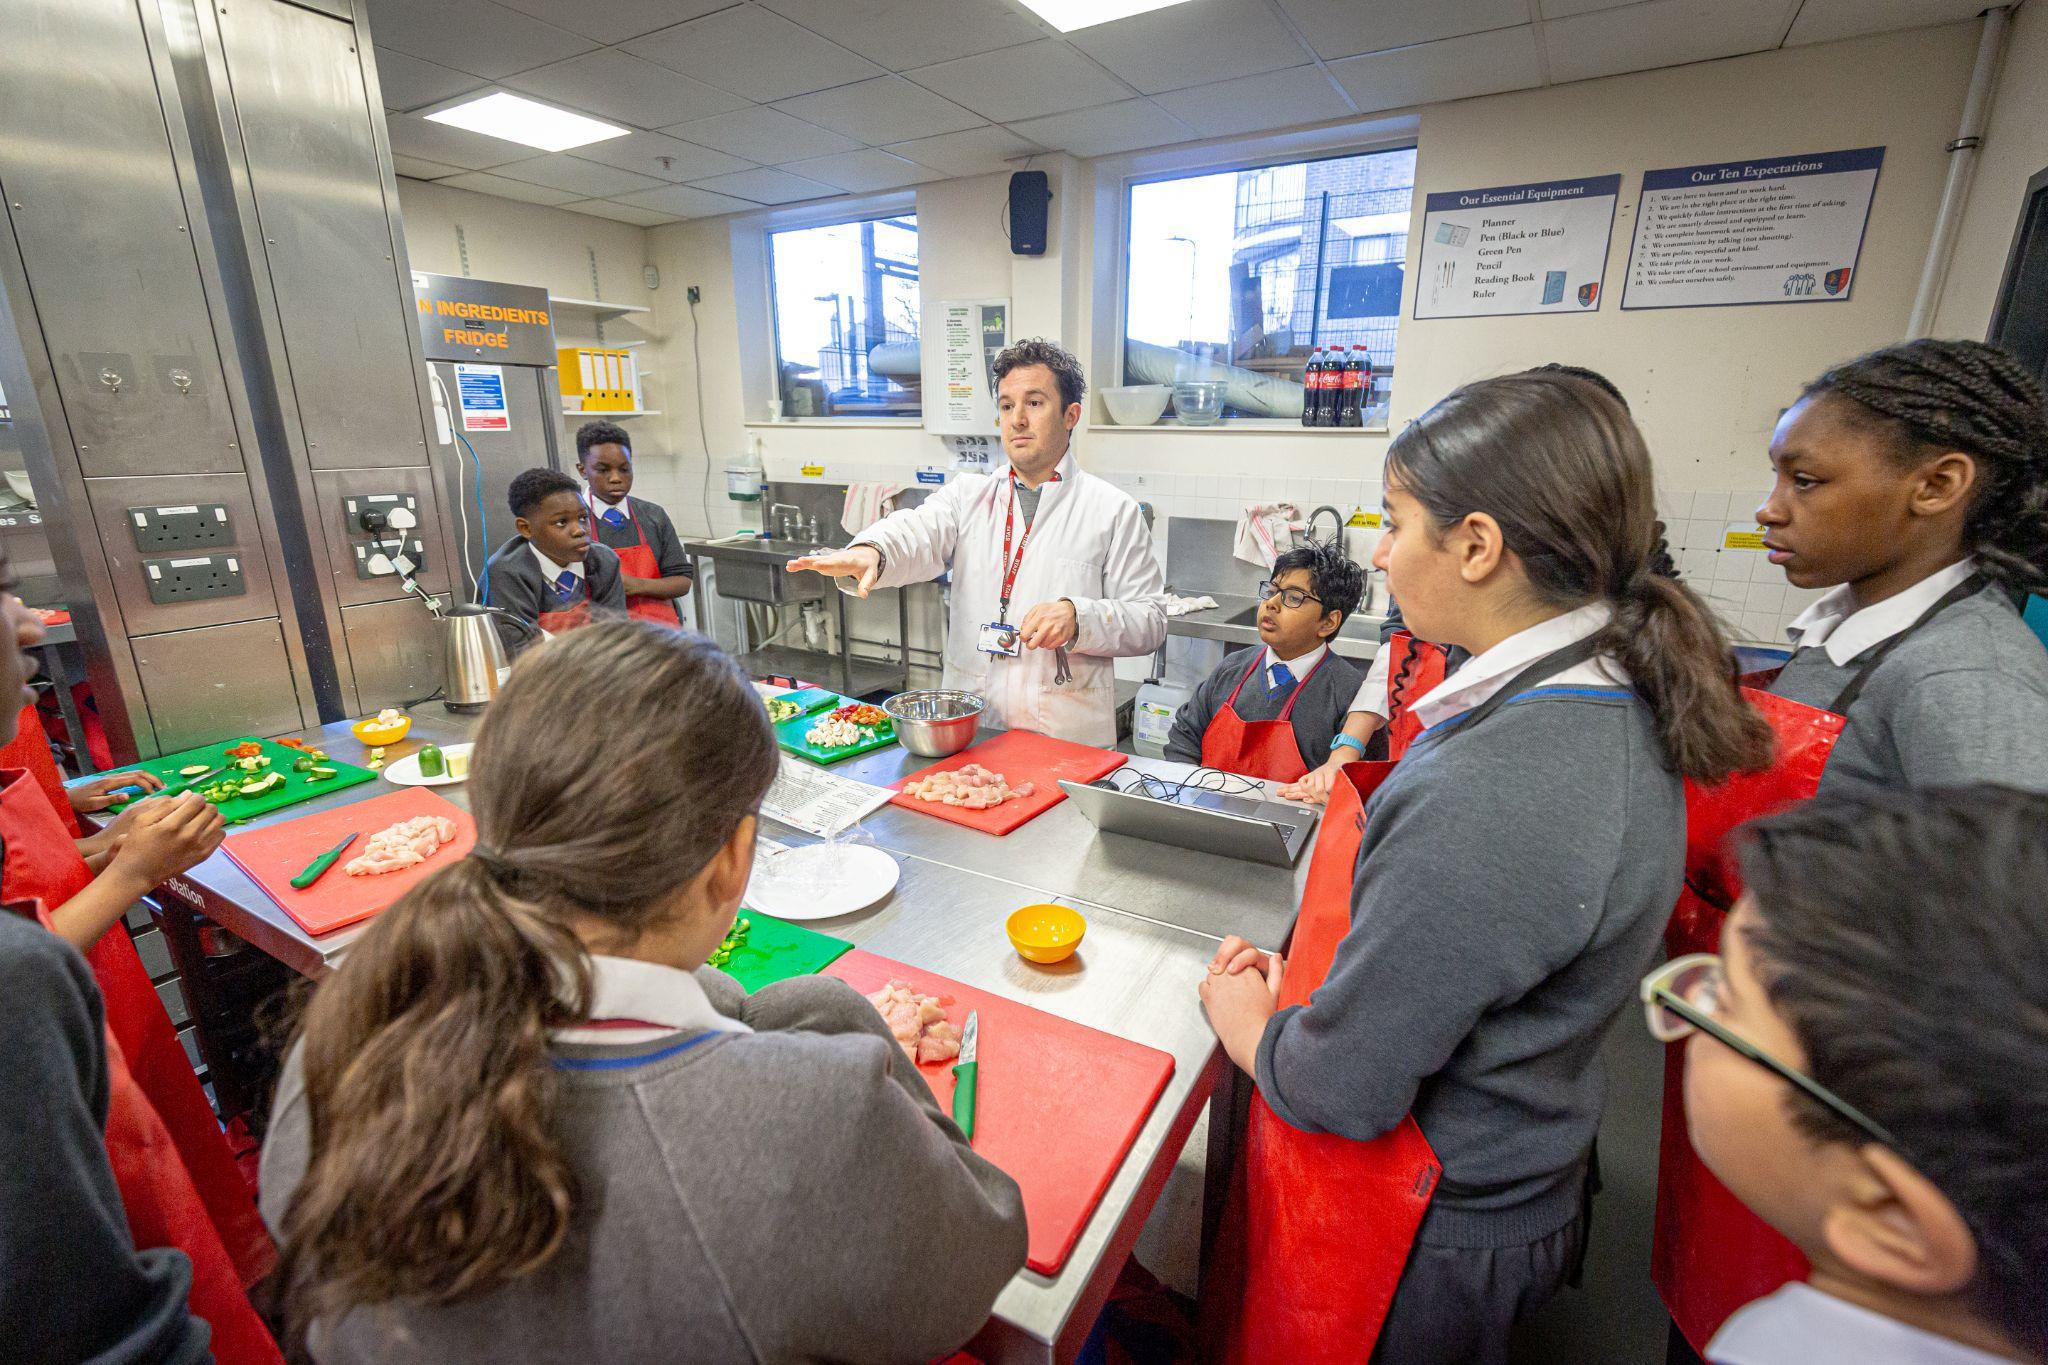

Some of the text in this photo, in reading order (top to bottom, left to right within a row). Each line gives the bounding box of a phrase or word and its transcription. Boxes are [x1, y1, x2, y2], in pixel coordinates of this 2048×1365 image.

[1691, 161, 1823, 182] Our Ten Expectations
[1460, 186, 1584, 206] Our Essential Equipment
[1703, 200, 1719, 209] right
[1720, 199, 1737, 208] place
[1760, 195, 1777, 204] right
[1669, 212, 1693, 222] quickly
[1717, 207, 1757, 215] instructions
[1822, 200, 1847, 208] asking.
[1482, 219, 1516, 228] Planner
[1679, 221, 1702, 229] smartly
[1704, 218, 1728, 226] dressed
[1744, 214, 1776, 225] equipped
[1480, 233, 1496, 242] Pen
[1498, 231, 1525, 242] (Black
[1541, 227, 1565, 237] Blue)
[1664, 239, 1707, 247] communicate
[1708, 238, 1716, 246] by
[1718, 237, 1742, 245] talking
[1743, 235, 1758, 244] (not
[1759, 233, 1794, 242] shouting).
[1666, 231, 1694, 240] complete
[1697, 228, 1731, 236] homework
[1478, 246, 1522, 256] Green Pen
[1695, 247, 1727, 256] respectful
[1476, 261, 1502, 270] Pencil
[1675, 259, 1691, 267] pride
[1731, 263, 1774, 271] environment
[1791, 260, 1830, 270] equipment.
[1475, 273, 1535, 285] Reading Book
[1717, 275, 1736, 283] safely.
[1473, 290, 1496, 298] Ruler
[436, 300, 549, 326] INGREDIENTS
[443, 328, 509, 349] FRIDGE
[28, 515, 42, 524] S
[1011, 558, 1021, 576] STAFF
[169, 877, 206, 909] Station
